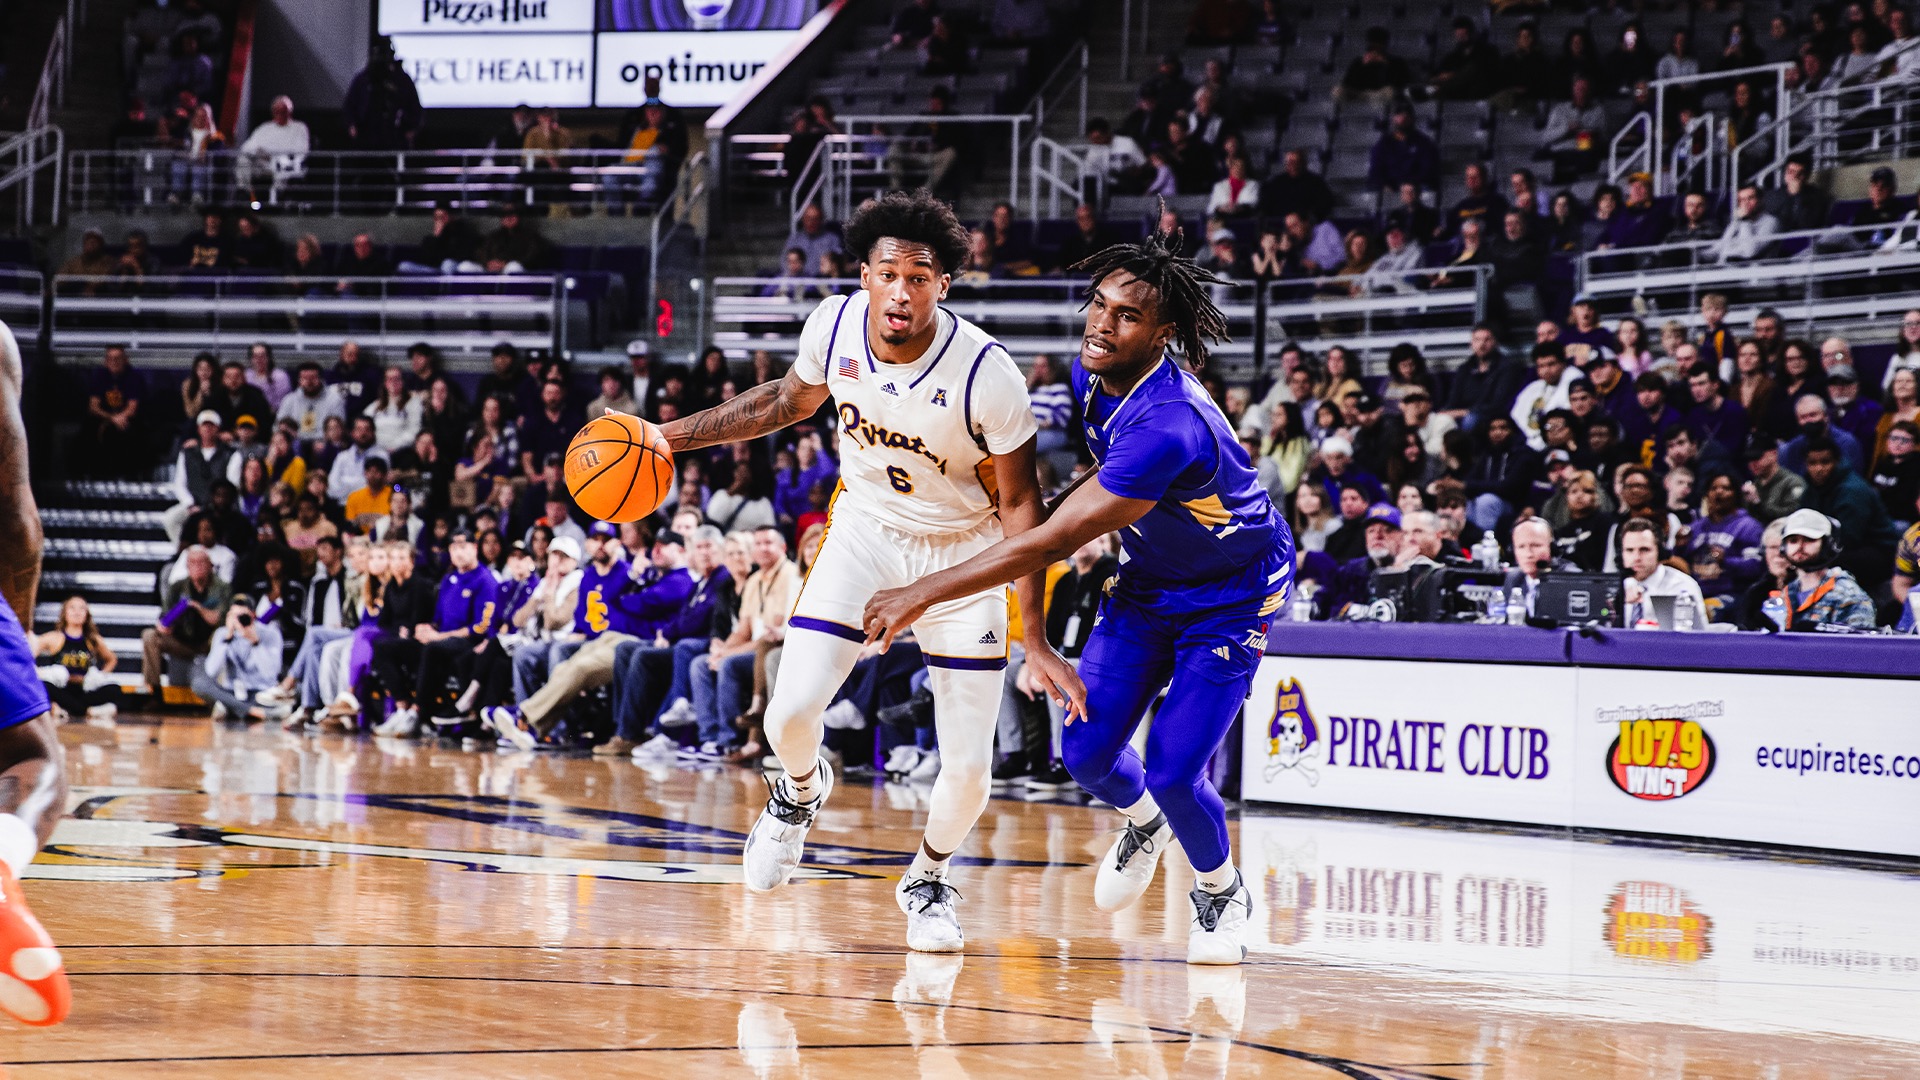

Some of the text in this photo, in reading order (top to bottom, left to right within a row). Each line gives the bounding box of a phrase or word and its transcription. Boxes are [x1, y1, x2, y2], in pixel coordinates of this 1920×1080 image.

[501, 0, 547, 22] Hut
[413, 58, 585, 83] ECU HEALTH
[886, 464, 914, 496] 6
[1326, 716, 1550, 780] PIRATE CLUB
[1618, 719, 1704, 769] 107.9
[1756, 742, 1920, 778] ecupirates.co
[1625, 765, 1688, 797] WNCT
